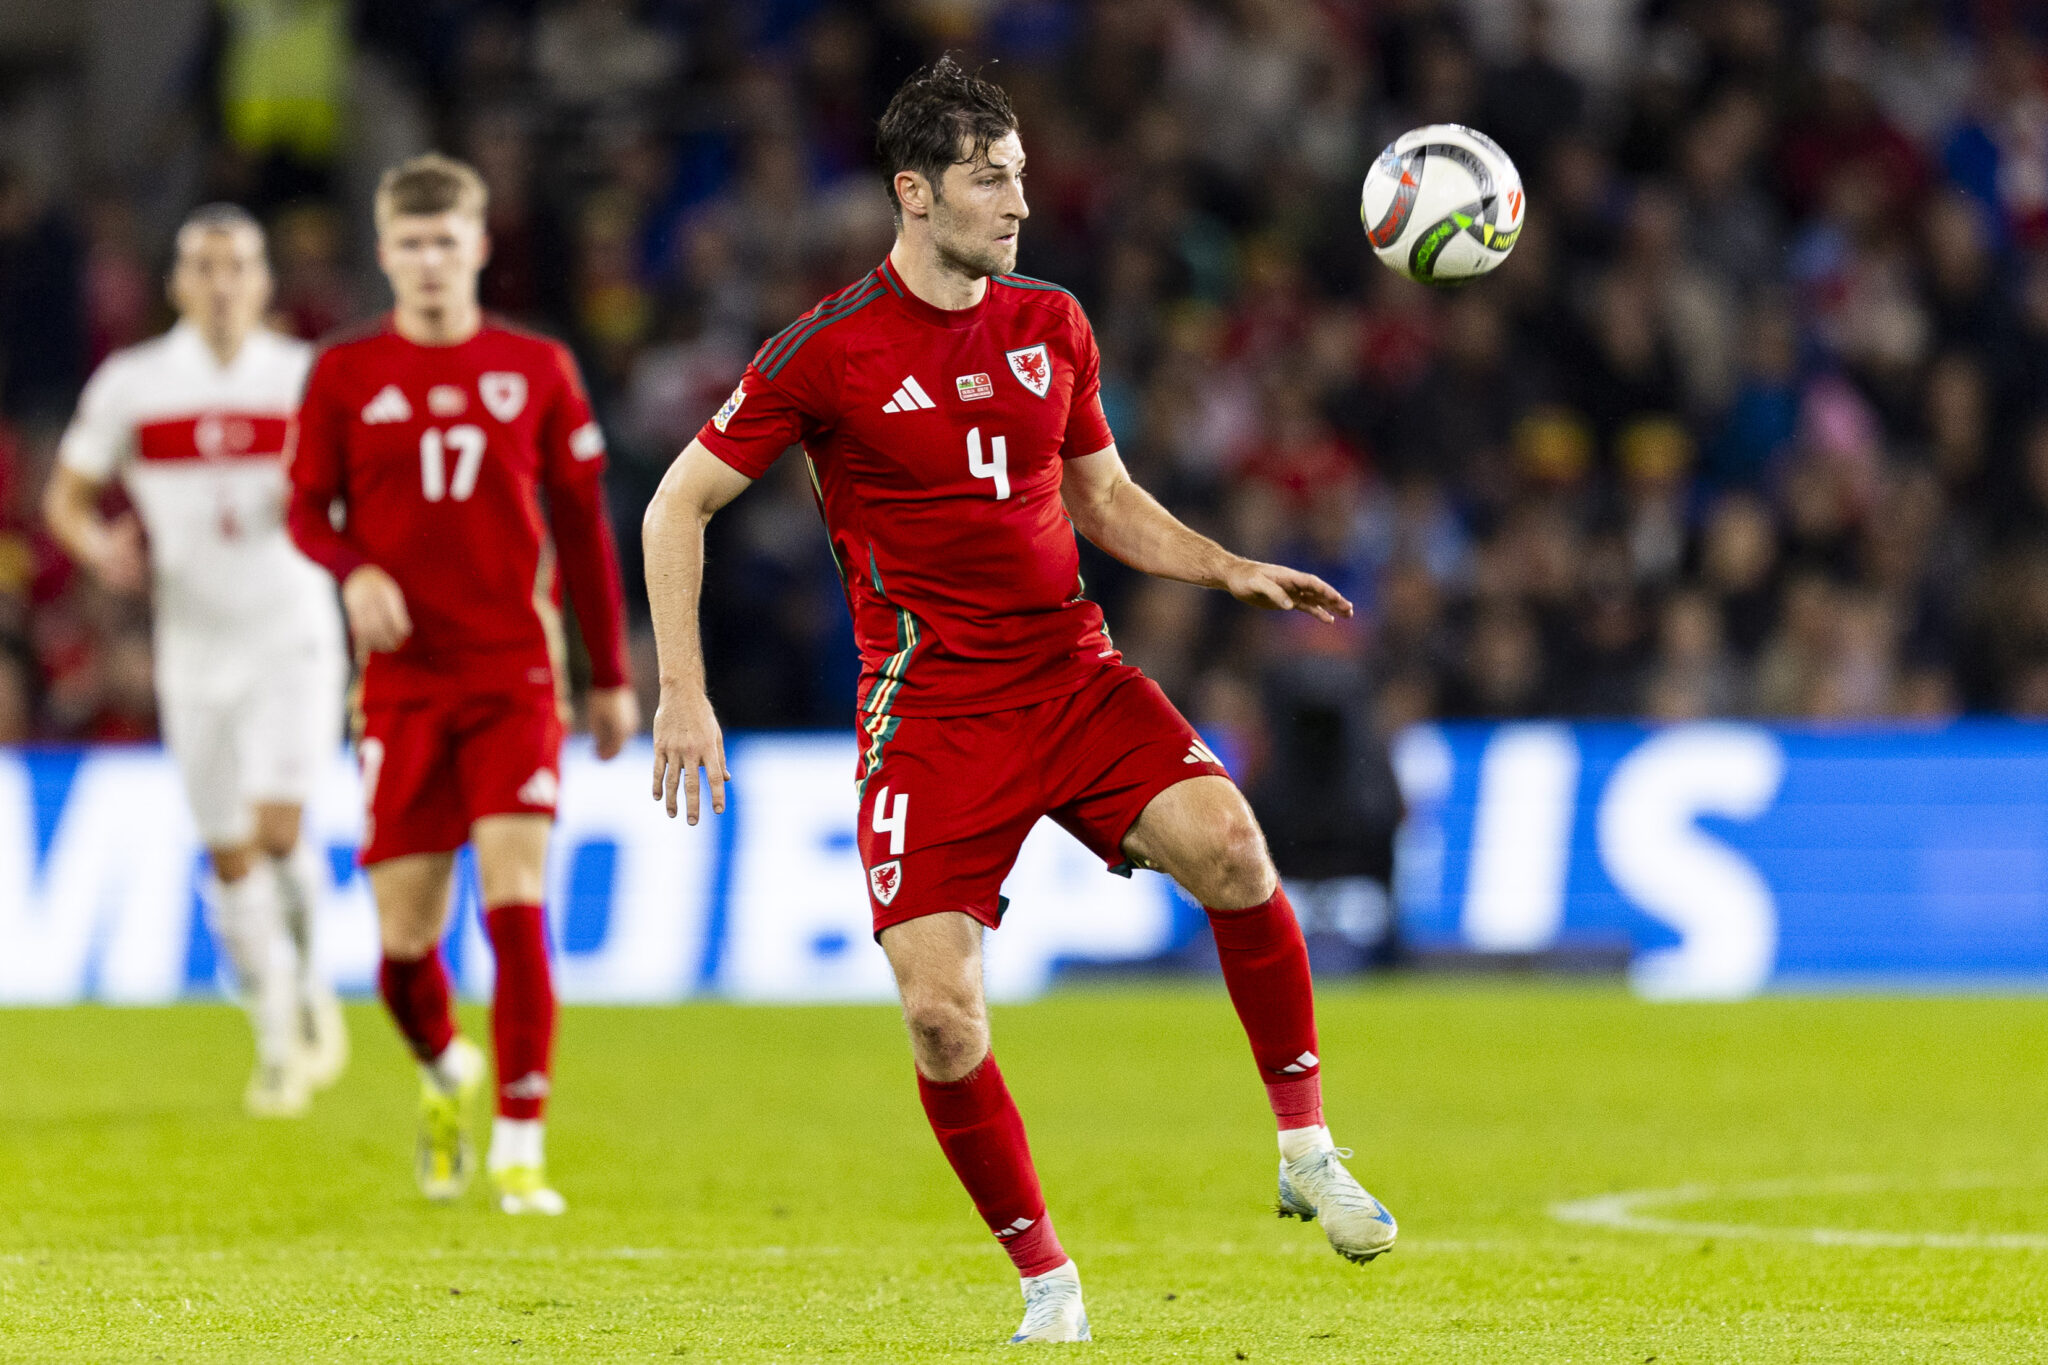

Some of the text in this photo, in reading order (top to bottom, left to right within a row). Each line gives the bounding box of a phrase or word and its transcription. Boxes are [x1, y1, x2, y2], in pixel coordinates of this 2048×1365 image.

[419, 423, 488, 503] 17
[966, 426, 1011, 501] 4
[872, 785, 909, 855] 4
